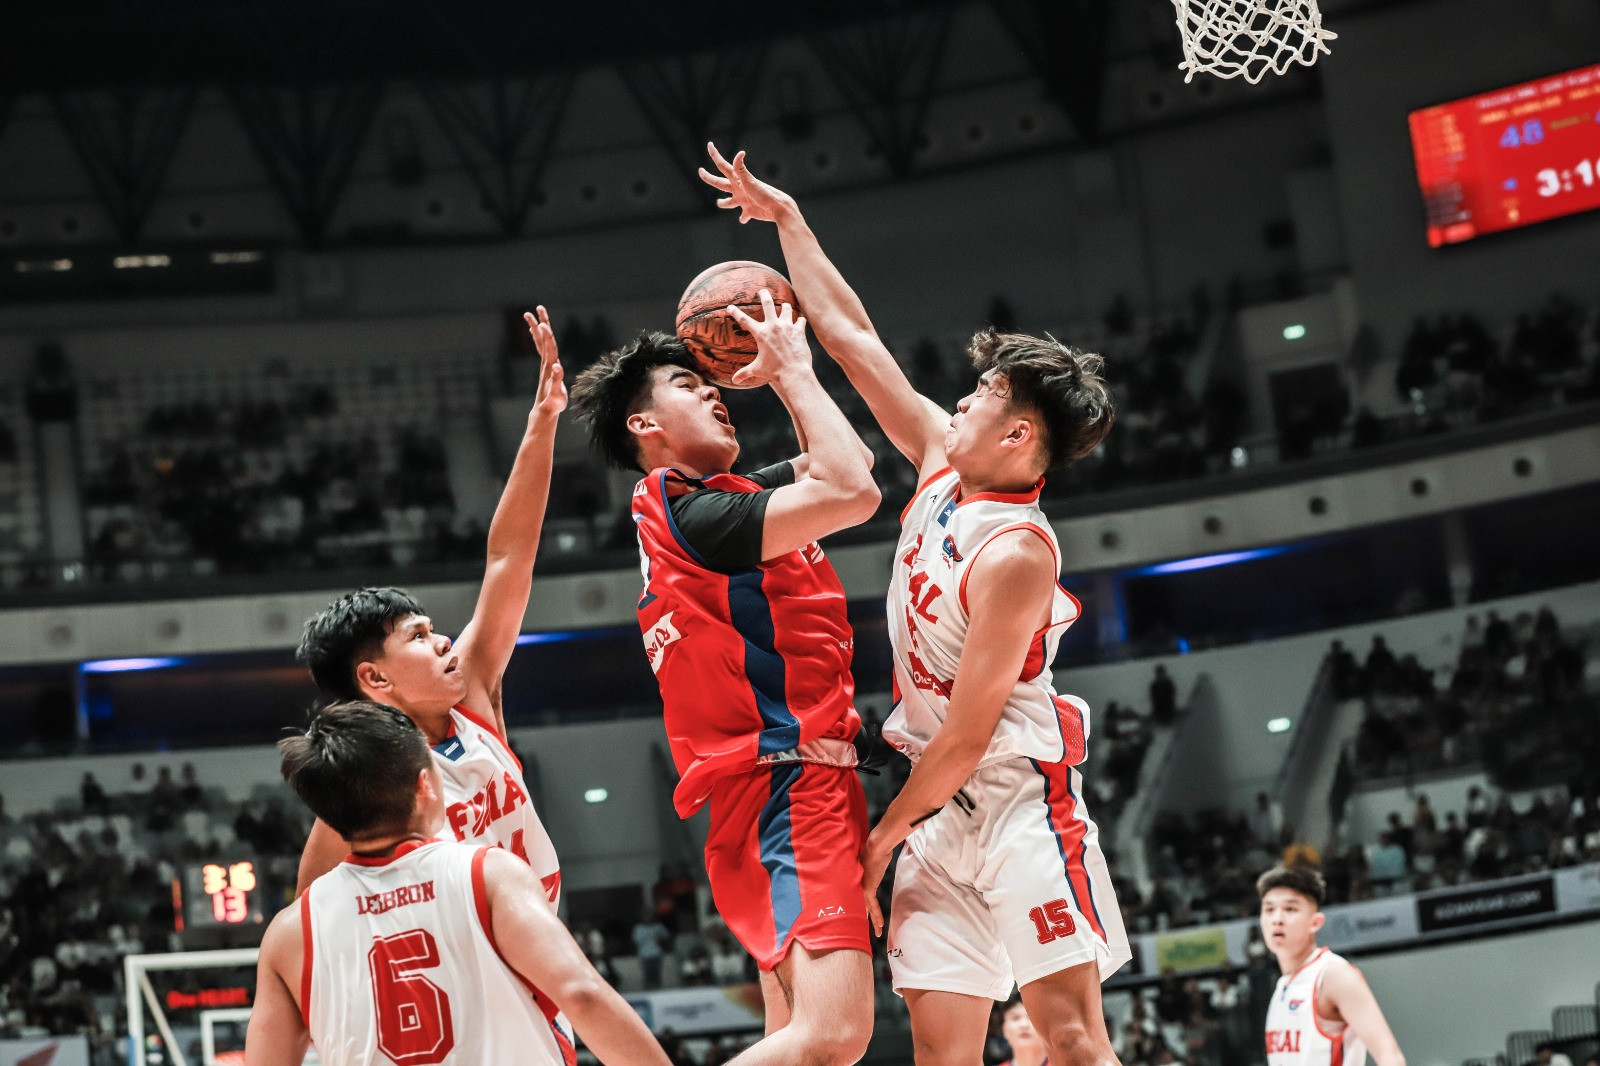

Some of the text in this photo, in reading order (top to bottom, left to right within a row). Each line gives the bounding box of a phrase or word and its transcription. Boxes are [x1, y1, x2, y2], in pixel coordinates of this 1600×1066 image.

[1536, 157, 1600, 197] 3:1
[213, 886, 248, 923] 13
[355, 880, 436, 915] LEBRON
[1029, 898, 1076, 944] 15
[368, 928, 454, 1066] 6
